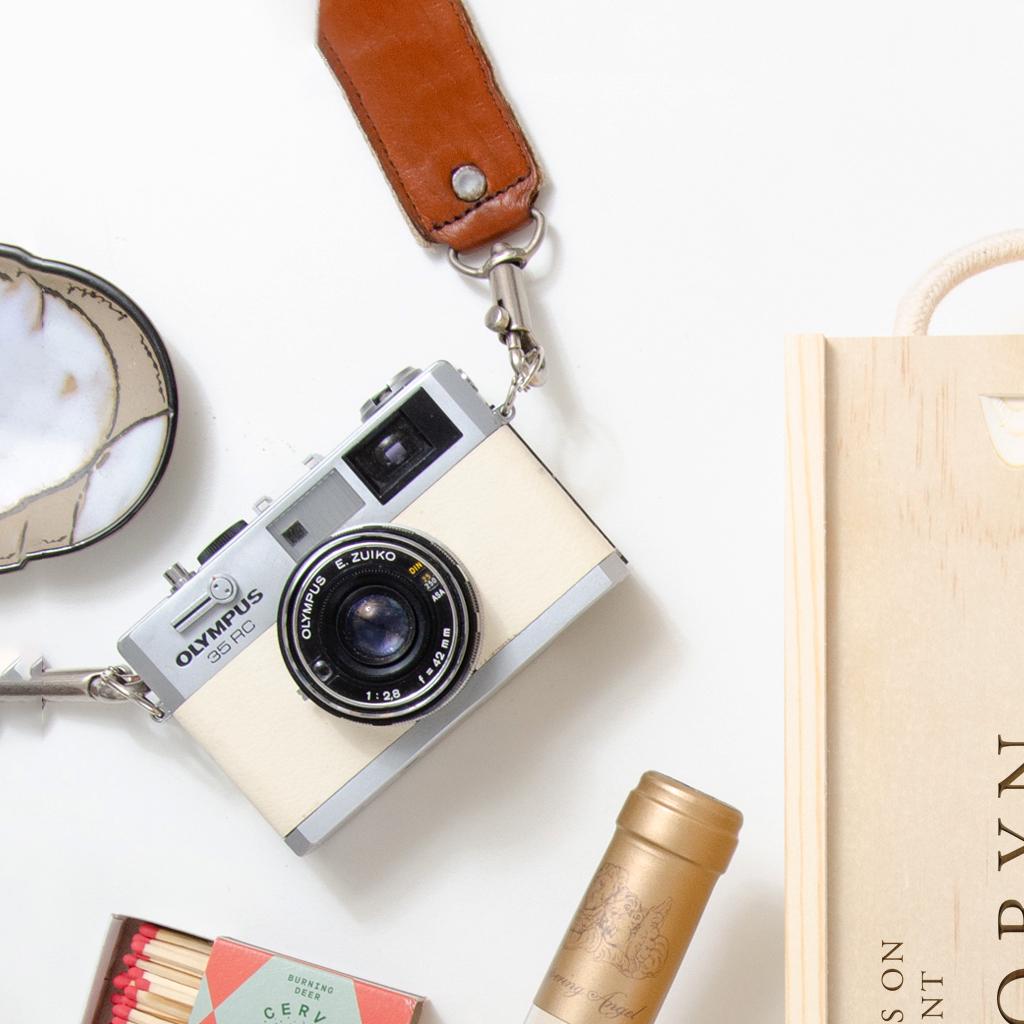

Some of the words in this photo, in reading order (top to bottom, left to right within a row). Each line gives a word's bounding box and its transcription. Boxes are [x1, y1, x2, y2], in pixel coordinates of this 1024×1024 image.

[351, 550, 396, 563] ZUIKO
[408, 561, 424, 575] DIN
[301, 575, 327, 640] OLYMPUS
[431, 589, 446, 602] ASA
[176, 588, 264, 667] OLYMPUS
[207, 640, 232, 664] 35
[230, 619, 256, 644] RC
[881, 940, 904, 992] ON
[287, 974, 334, 994] BURNING
[294, 987, 321, 1001] DEER
[587, 991, 647, 1020] Angel
